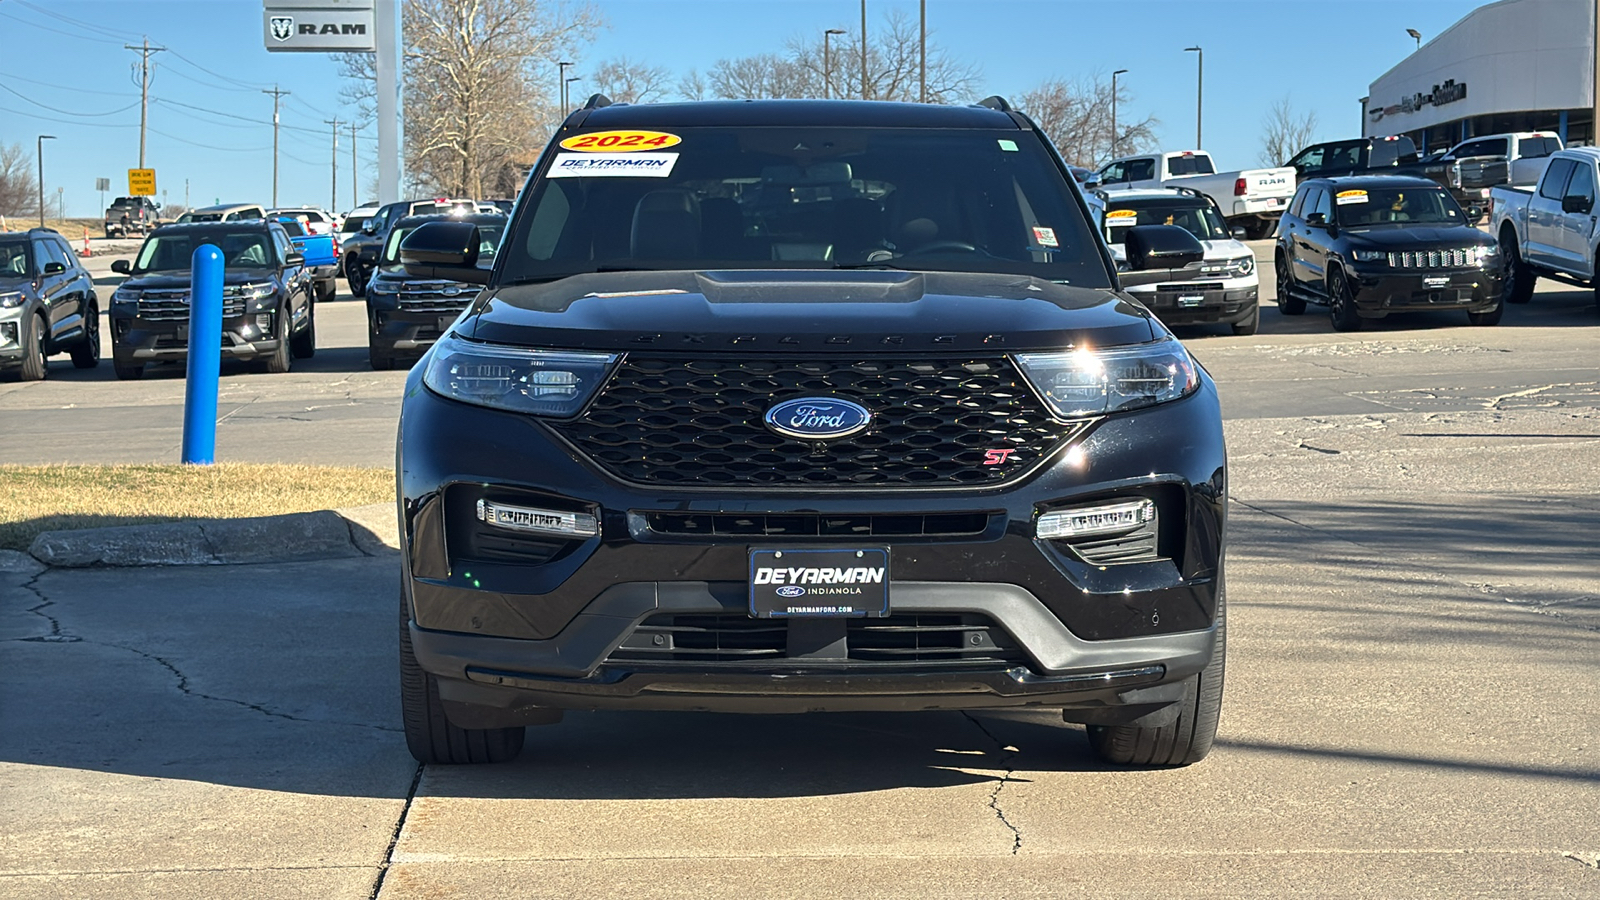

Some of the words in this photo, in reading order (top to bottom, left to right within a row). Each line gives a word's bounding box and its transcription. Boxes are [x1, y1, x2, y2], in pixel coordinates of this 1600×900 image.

[298, 24, 366, 35] RAM
[571, 135, 669, 147] 2024
[790, 405, 846, 428] Ford
[983, 448, 1016, 465] ST
[754, 567, 884, 584] DEYARMAN
[807, 587, 862, 595] INDIANOLA
